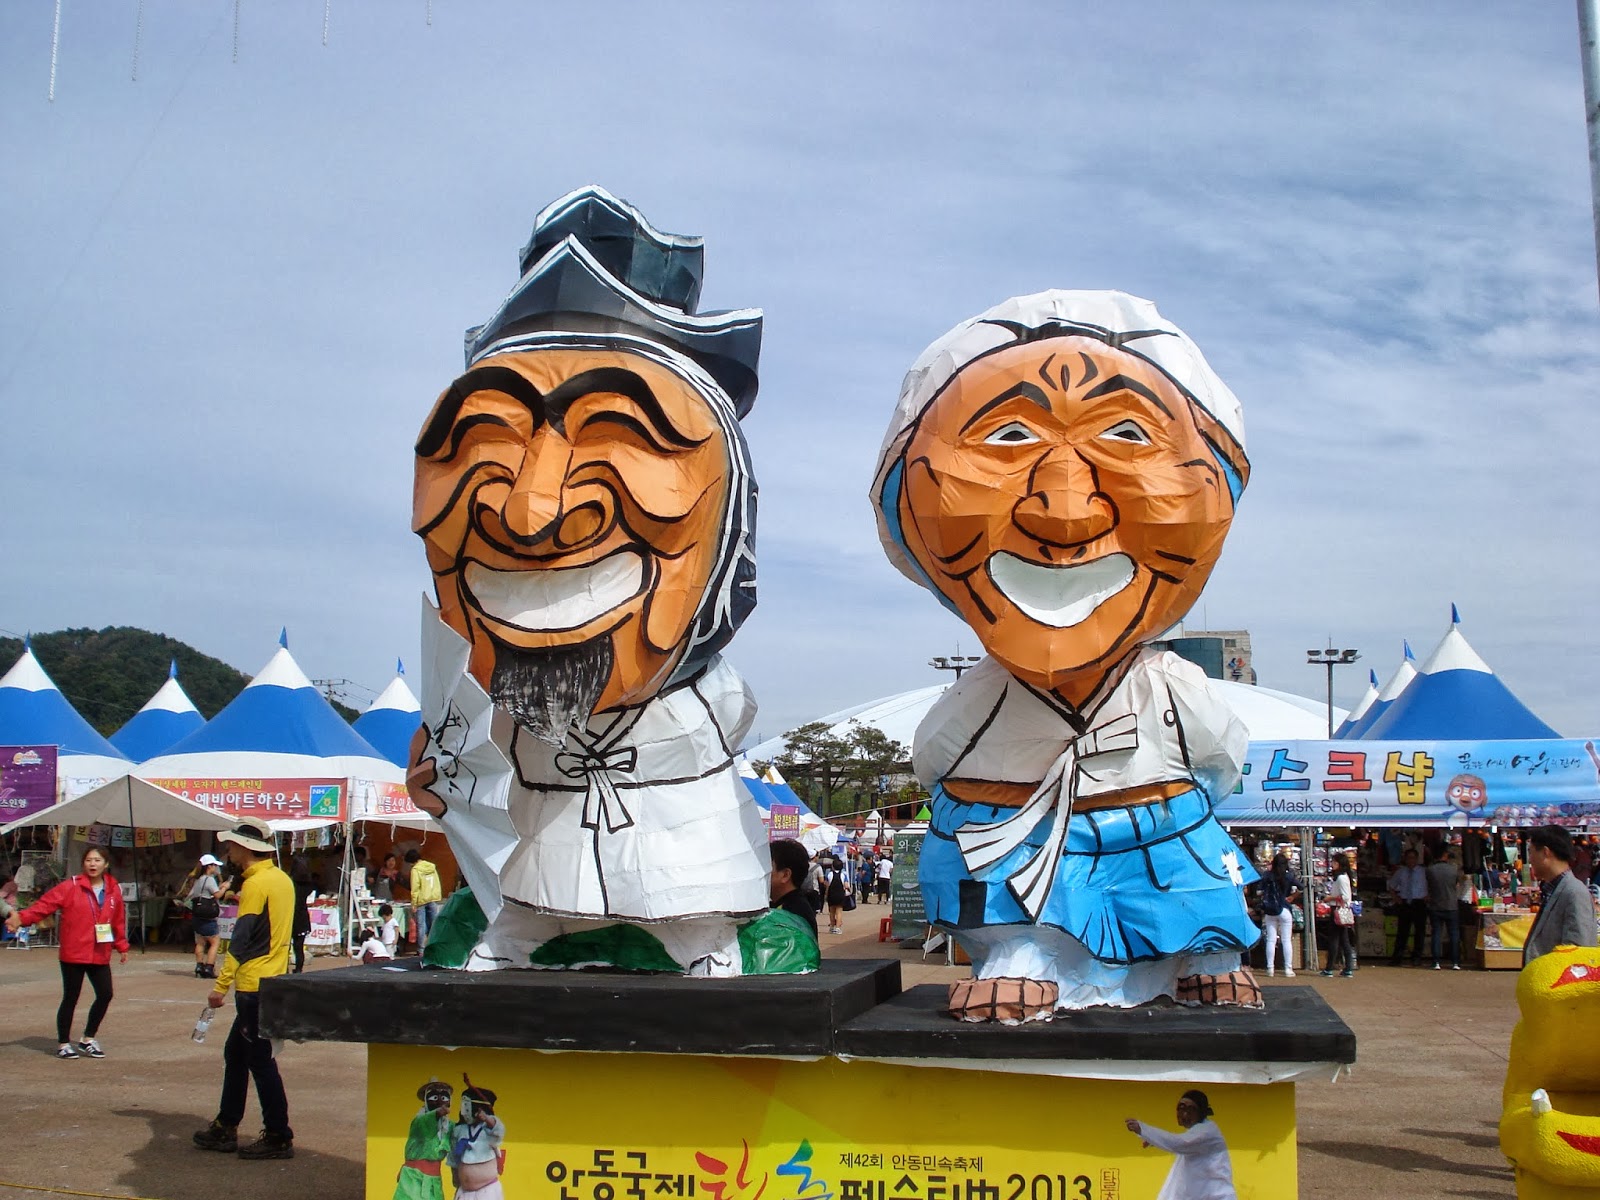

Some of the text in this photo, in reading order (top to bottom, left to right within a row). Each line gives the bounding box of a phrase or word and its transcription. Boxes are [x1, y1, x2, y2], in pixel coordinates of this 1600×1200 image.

[1265, 799, 1369, 815] (Mask Shop)
[839, 1152, 984, 1173] 제42회 안동민속축제
